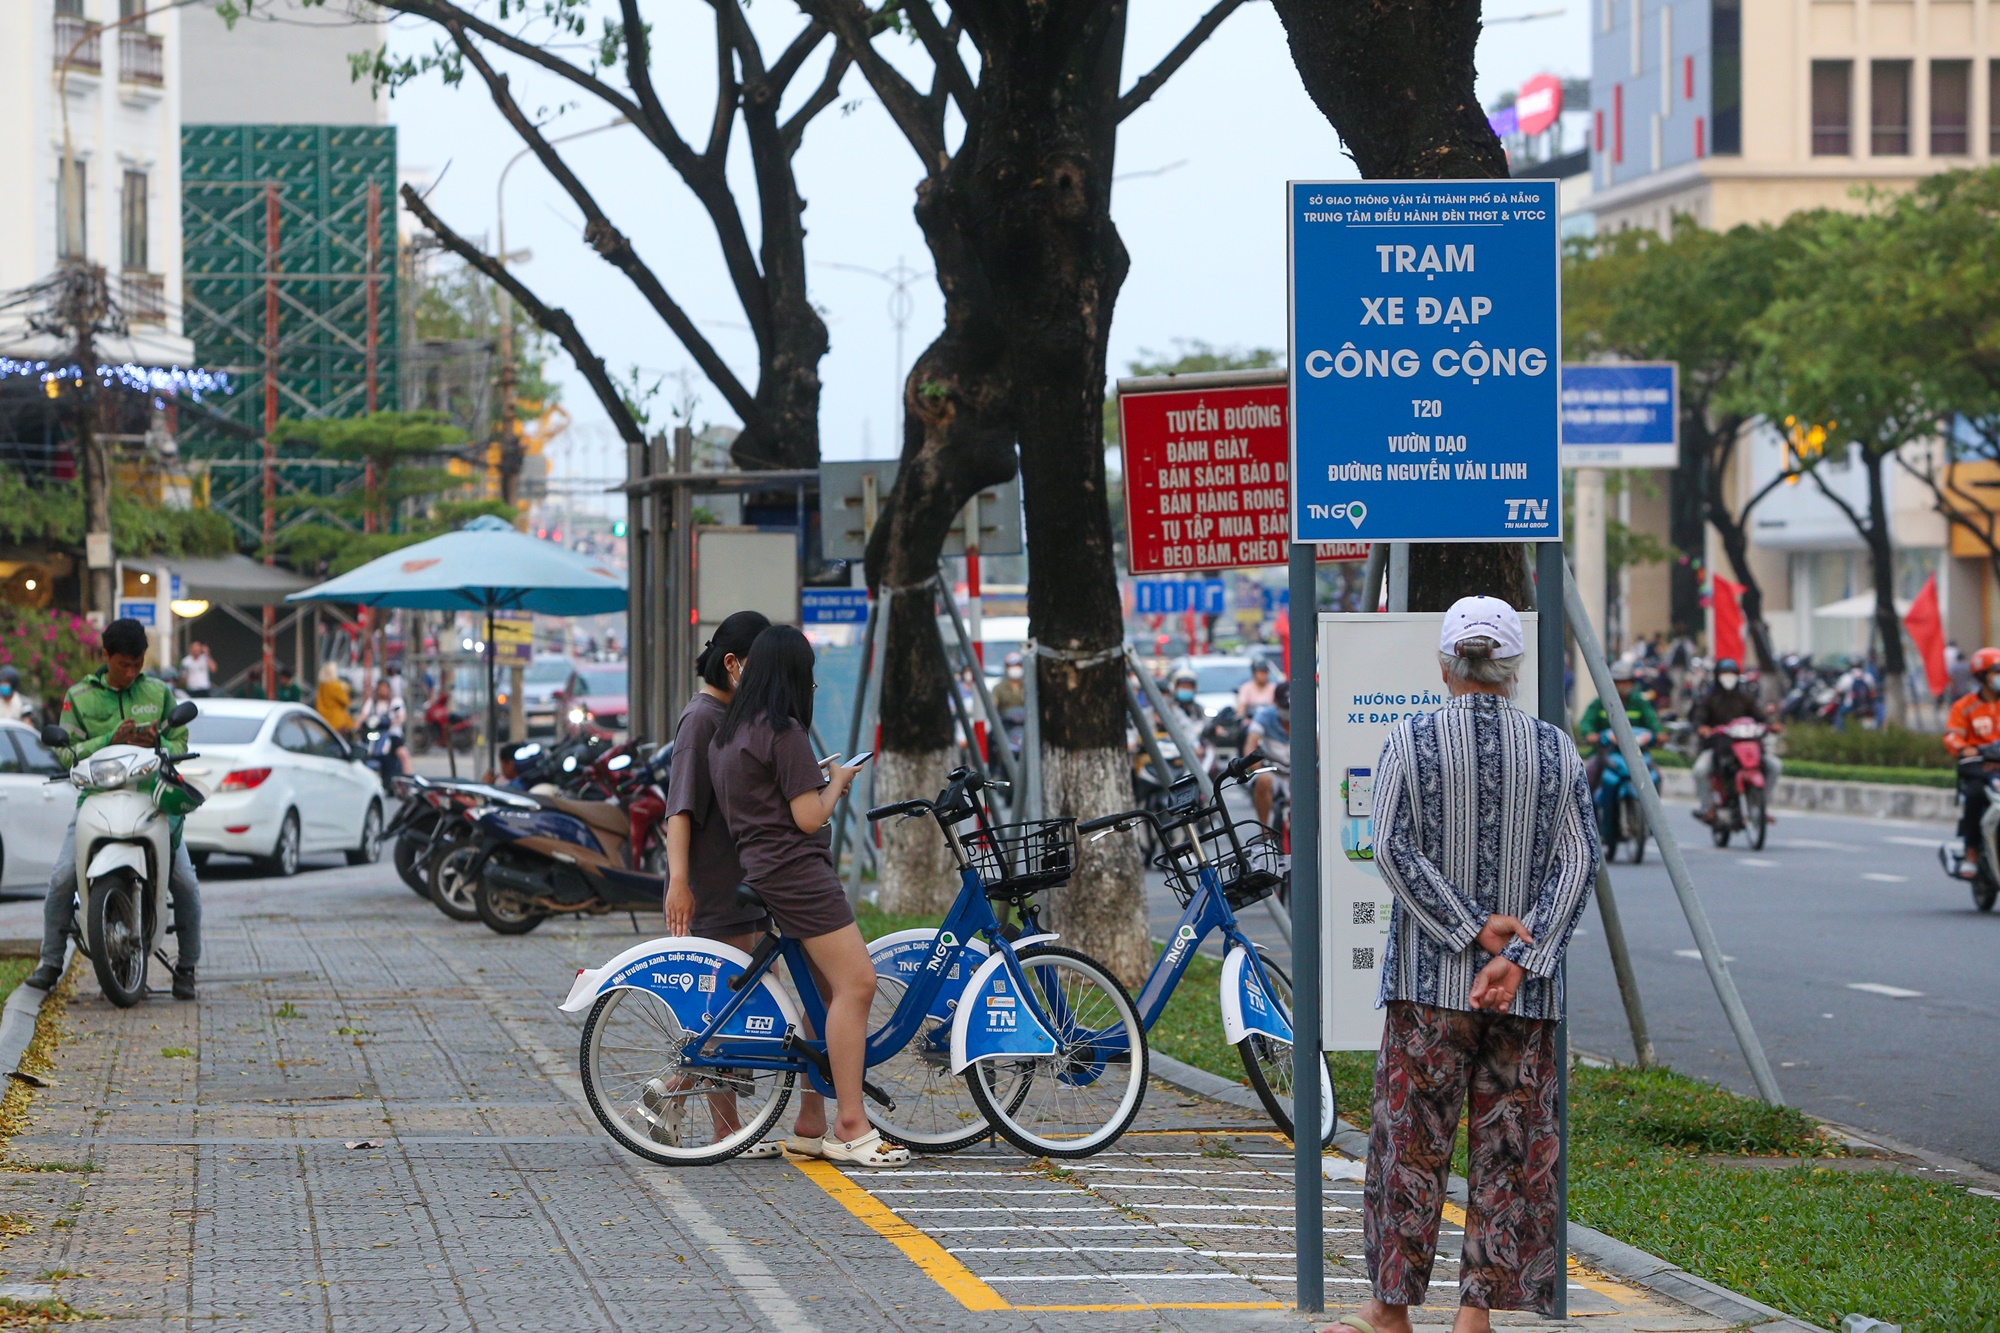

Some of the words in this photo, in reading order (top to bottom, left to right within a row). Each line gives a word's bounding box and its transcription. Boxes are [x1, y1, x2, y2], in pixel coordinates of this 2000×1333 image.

[1309, 194, 1322, 204] SỞ
[1326, 196, 1352, 204] GIAO
[1354, 194, 1389, 204] THÔNG
[1392, 194, 1412, 206] VẬN
[1416, 193, 1430, 204] TẢI
[1434, 194, 1466, 204] THÀNH
[1470, 192, 1490, 204] PHỐ
[1493, 193, 1508, 203] ĐÀ
[1510, 192, 1540, 203] NẴNG
[1304, 212, 1343, 222] TRUNG
[1346, 210, 1370, 222] TÂM
[1374, 207, 1400, 222] ĐIỀU
[1404, 209, 1438, 221] HÀNH
[1442, 209, 1464, 221] ĐÈN
[1468, 211, 1498, 220] THGT
[1502, 211, 1510, 220] &
[1513, 210, 1546, 220] VTCC
[1376, 244, 1474, 281] TRẠM
[1360, 297, 1404, 325] XE
[1416, 296, 1492, 333] ĐẠP
[1305, 342, 1420, 378] CÔNG
[1432, 340, 1547, 384] CỘNG
[1224, 401, 1281, 430] ĐƯỜNG
[1412, 400, 1442, 418] T20
[1166, 437, 1209, 463] ĐÁNH
[1214, 435, 1253, 460] GIÀY.
[1388, 432, 1430, 452] VƯỜN
[1435, 435, 1467, 455] DẠO
[1158, 463, 1190, 489] BÁN
[1194, 461, 1235, 487] SÁCH
[1240, 459, 1270, 484] BÁO
[1328, 461, 1382, 481] ĐƯỜNG
[1387, 458, 1450, 481] NGUYỄN
[1455, 459, 1486, 480] VĂN
[1492, 463, 1527, 480] LINH
[1160, 490, 1192, 515] BÁN
[1196, 488, 1238, 512] HÀNG
[1504, 499, 1548, 520] TN
[1161, 520, 1180, 545] TỤ
[1185, 513, 1213, 542] TẬP
[1219, 516, 1254, 537] MUA
[1163, 545, 1192, 566] ĐEO
[1196, 540, 1237, 564] BÁM,
[1239, 537, 1278, 562] CHÈO
[1353, 692, 1406, 705] HƯỚNG
[1411, 690, 1441, 704] DẪN
[131, 704, 159, 715] Grab
[1348, 714, 1364, 723] XE
[1369, 713, 1398, 726] ĐẠP
[912, 941, 930, 950] Cuộc
[612, 975, 626, 985] Môi
[625, 961, 648, 977] trường
[668, 952, 685, 962] Cuộc
[686, 952, 703, 964] sống
[704, 956, 722, 969] khỏe
[750, 1018, 770, 1028] TN
[987, 1011, 1016, 1026] TN
